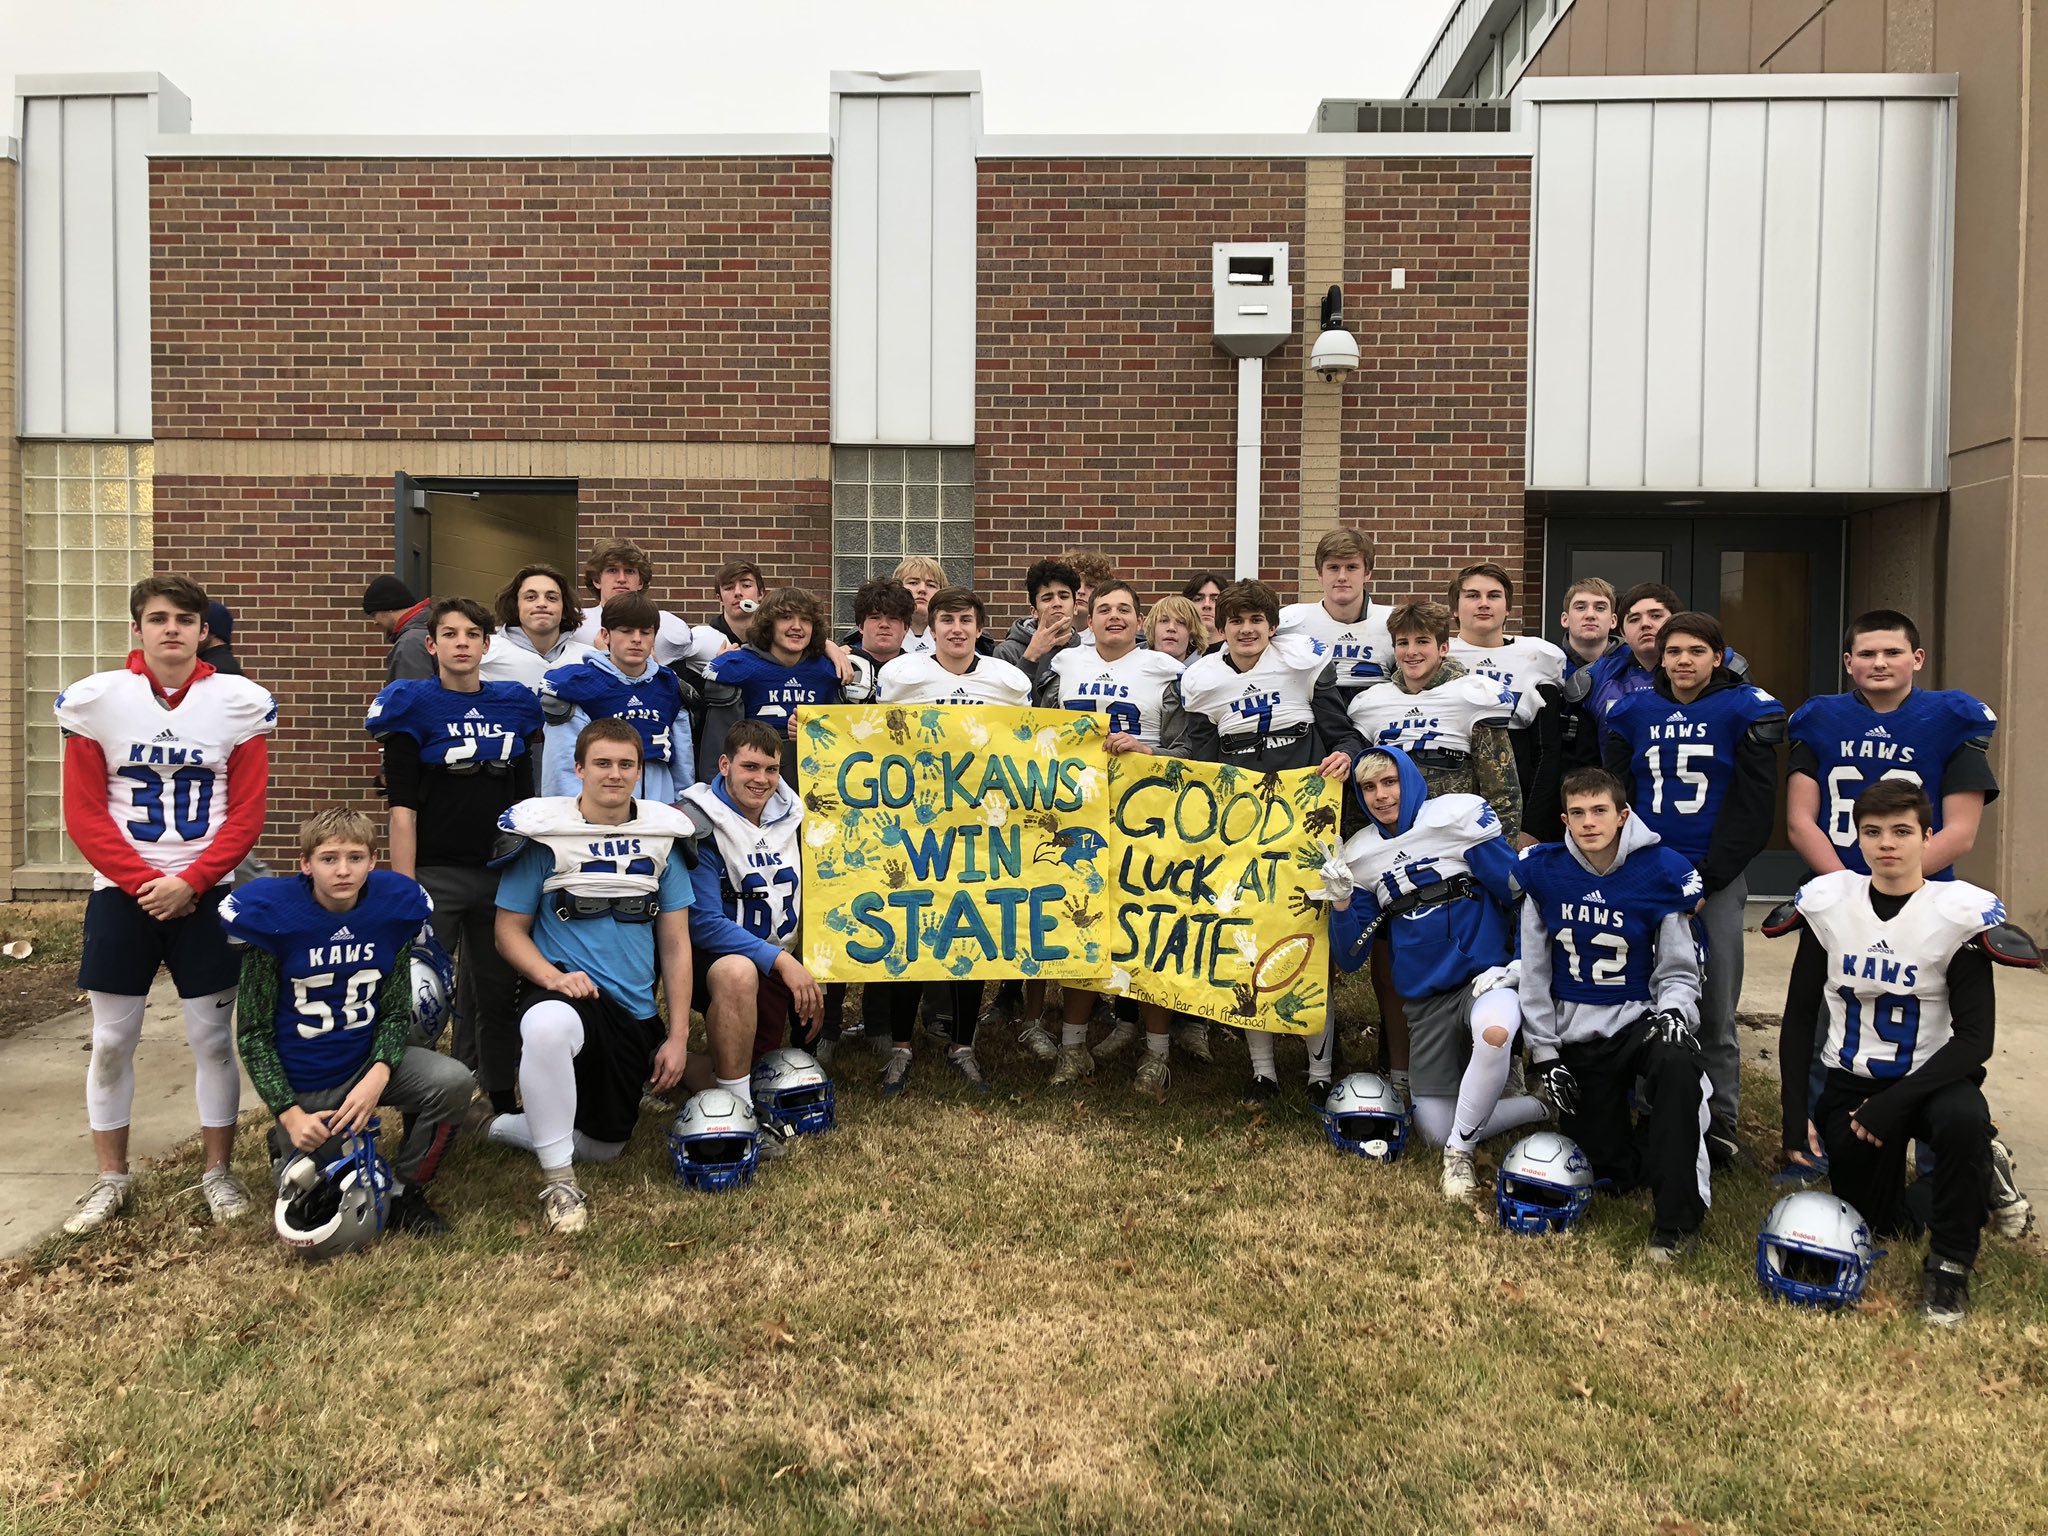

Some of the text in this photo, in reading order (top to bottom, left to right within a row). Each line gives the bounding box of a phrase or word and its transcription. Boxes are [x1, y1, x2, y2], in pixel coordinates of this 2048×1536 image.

[1333, 644, 1374, 660] AWS
[769, 690, 816, 703] KAWS
[1078, 683, 1129, 698] KAWS
[447, 722, 503, 737] KAWS
[1650, 723, 1708, 740] KAWS
[129, 744, 204, 765] KAWS
[1841, 740, 1915, 763] KAWS
[837, 751, 1087, 812] GO KAWS
[1644, 743, 1714, 814] 15
[117, 765, 216, 842] 30
[1115, 776, 1294, 846] GOOD
[588, 839, 641, 857] KAWS
[899, 823, 1022, 883] WIN
[1078, 833, 1099, 849] PL
[1118, 845, 1292, 905] LUCK AT
[845, 883, 1070, 965] STATE
[1561, 903, 1624, 928] KAWS
[309, 943, 375, 968] KAWS
[1111, 902, 1254, 988] STATE
[1555, 927, 1629, 986] 12
[1843, 954, 1918, 987] KAWS
[290, 968, 383, 1039] 58
[1129, 982, 1155, 1003] From
[1160, 991, 1169, 1008] 3
[1173, 992, 1192, 1012] Year
[1198, 1004, 1215, 1018] old
[1836, 984, 1921, 1081] 19
[1791, 1230, 1816, 1242] Riddell
